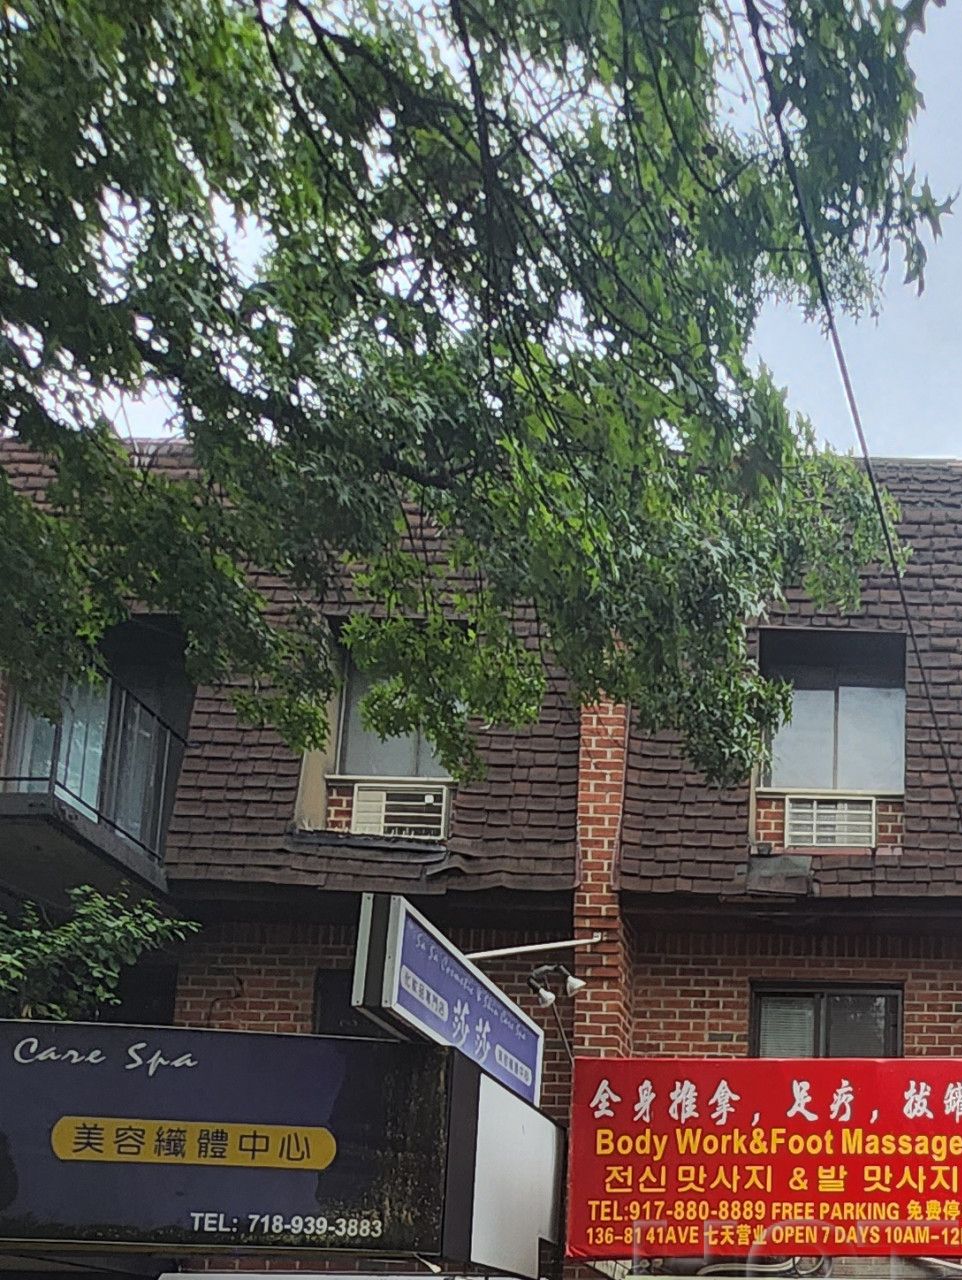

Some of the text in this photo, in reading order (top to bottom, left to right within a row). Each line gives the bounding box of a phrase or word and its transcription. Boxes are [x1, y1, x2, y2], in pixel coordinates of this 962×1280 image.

[14, 1037, 198, 1076] Care Spa
[596, 1128, 667, 1161] Body
[604, 1165, 666, 1193] 전신
[677, 1165, 772, 1194] 맛사지
[864, 1165, 958, 1194] 맛사지
[771, 1202, 816, 1221] FREE
[819, 1201, 900, 1221] PARKING
[190, 1212, 382, 1238] TEL: 718-939-3883
[704, 1224, 767, 1247] 七天营业
[772, 1225, 817, 1245] OPEN
[822, 1225, 830, 1245] 7
[835, 1225, 880, 1245] DAYS
